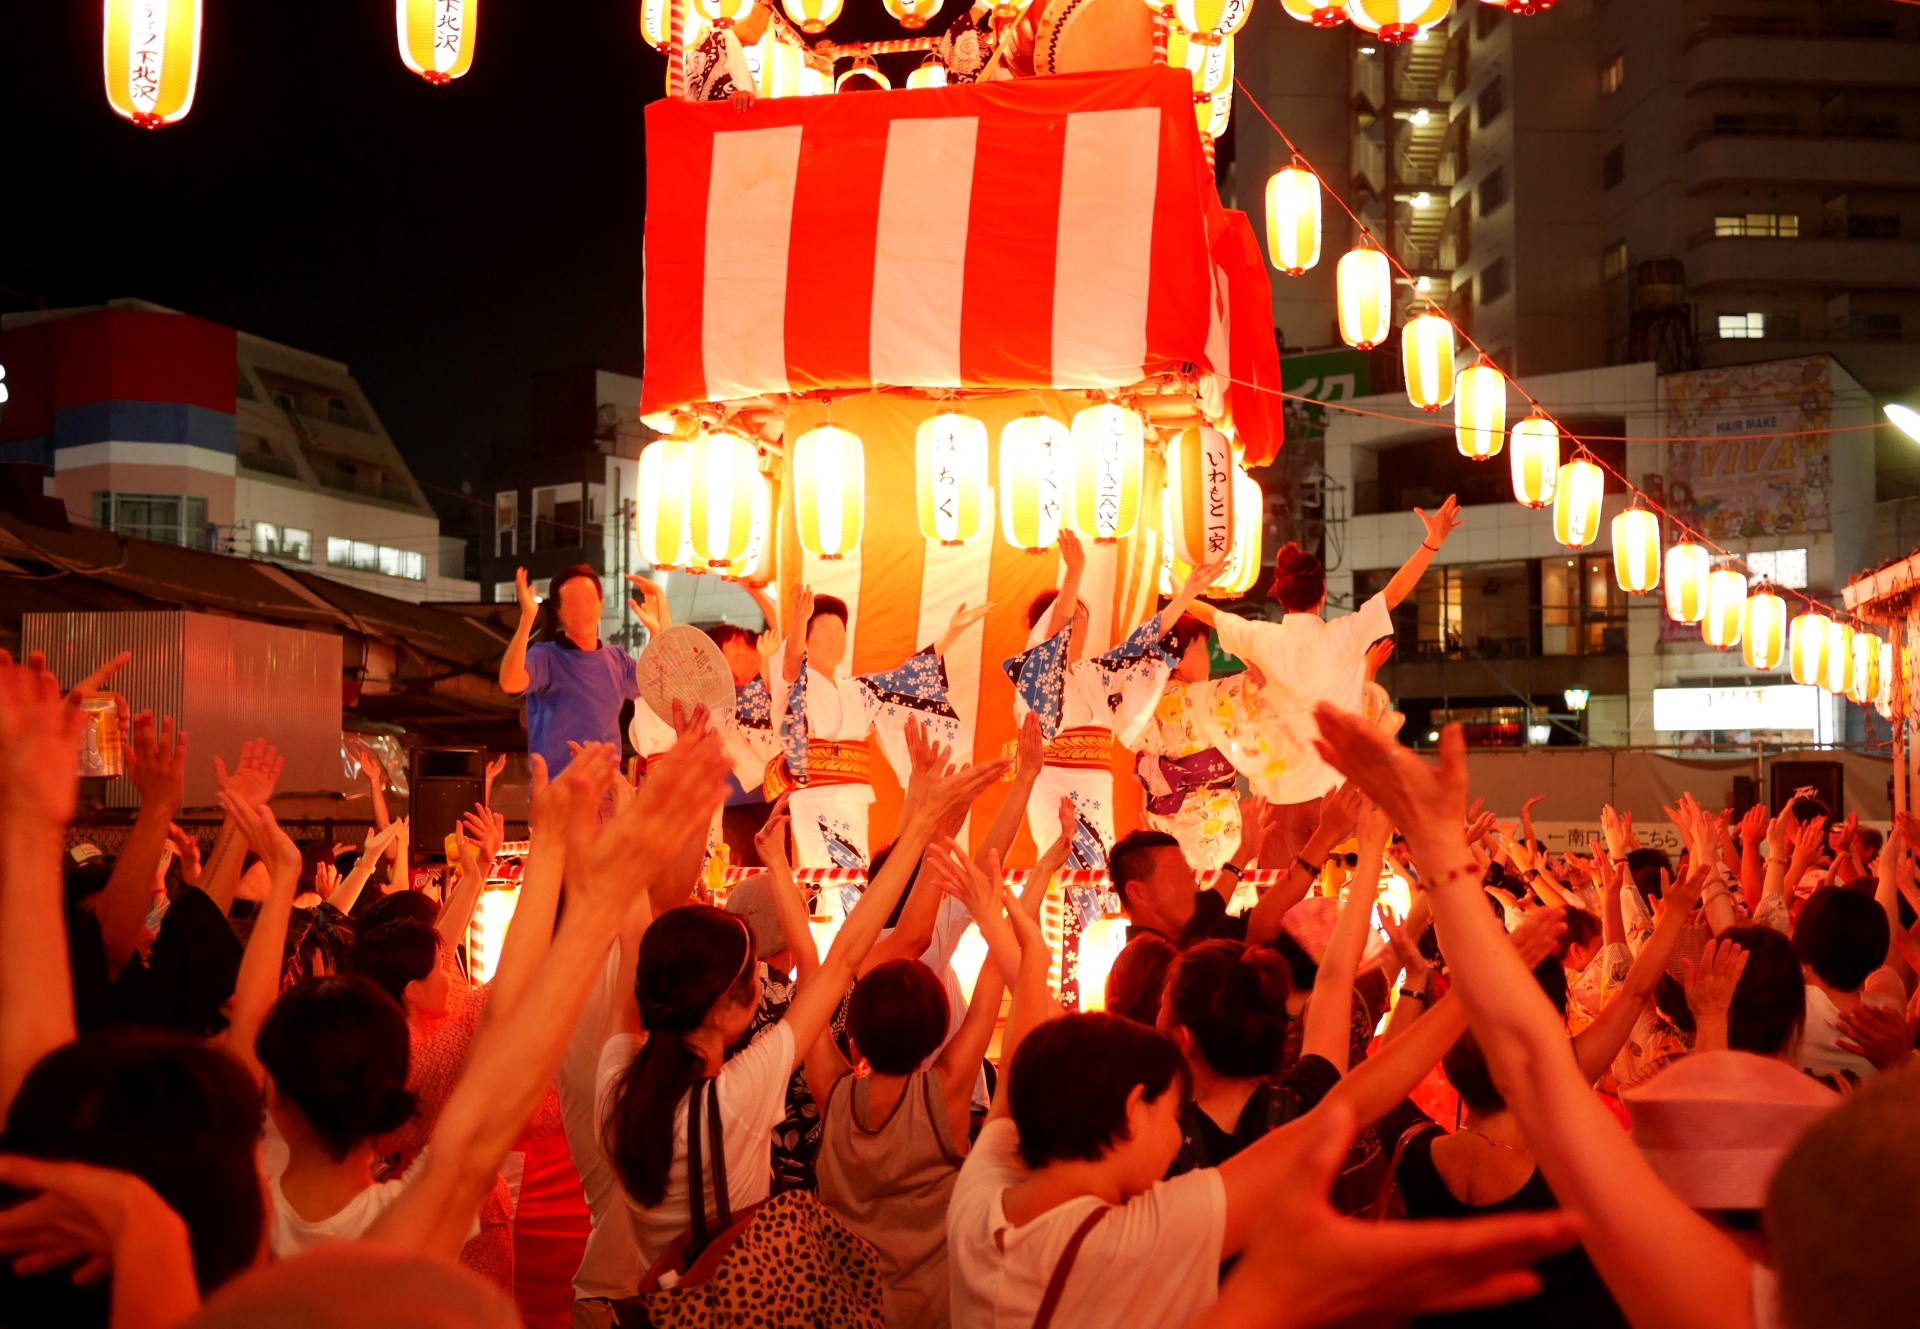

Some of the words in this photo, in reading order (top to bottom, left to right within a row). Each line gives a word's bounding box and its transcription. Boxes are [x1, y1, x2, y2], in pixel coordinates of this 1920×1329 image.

[1716, 420, 1743, 433] HAIR
[1746, 416, 1777, 429] MAKE
[1700, 436, 1796, 477] VIVA
[1206, 451, 1226, 553] いわもと一家
[1568, 828, 1678, 848] 南口こちら
